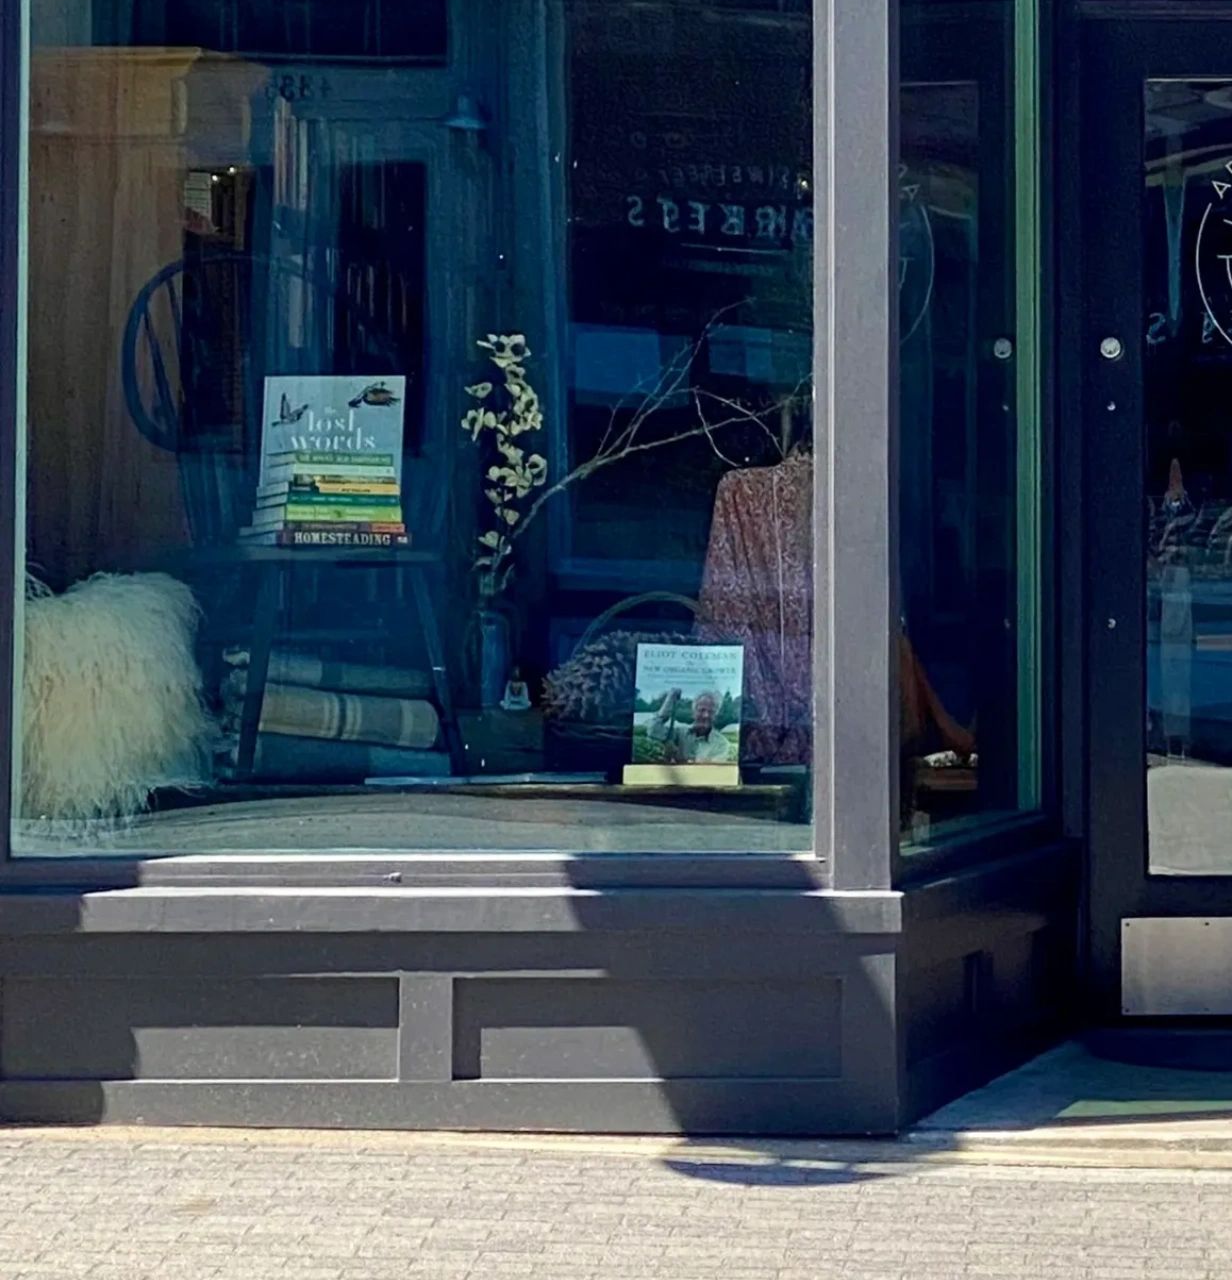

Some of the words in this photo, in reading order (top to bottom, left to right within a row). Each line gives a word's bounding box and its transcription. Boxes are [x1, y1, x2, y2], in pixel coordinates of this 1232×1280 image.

[306, 409, 355, 433] lost
[291, 426, 377, 450] words
[294, 531, 391, 546] HOMESTEADING
